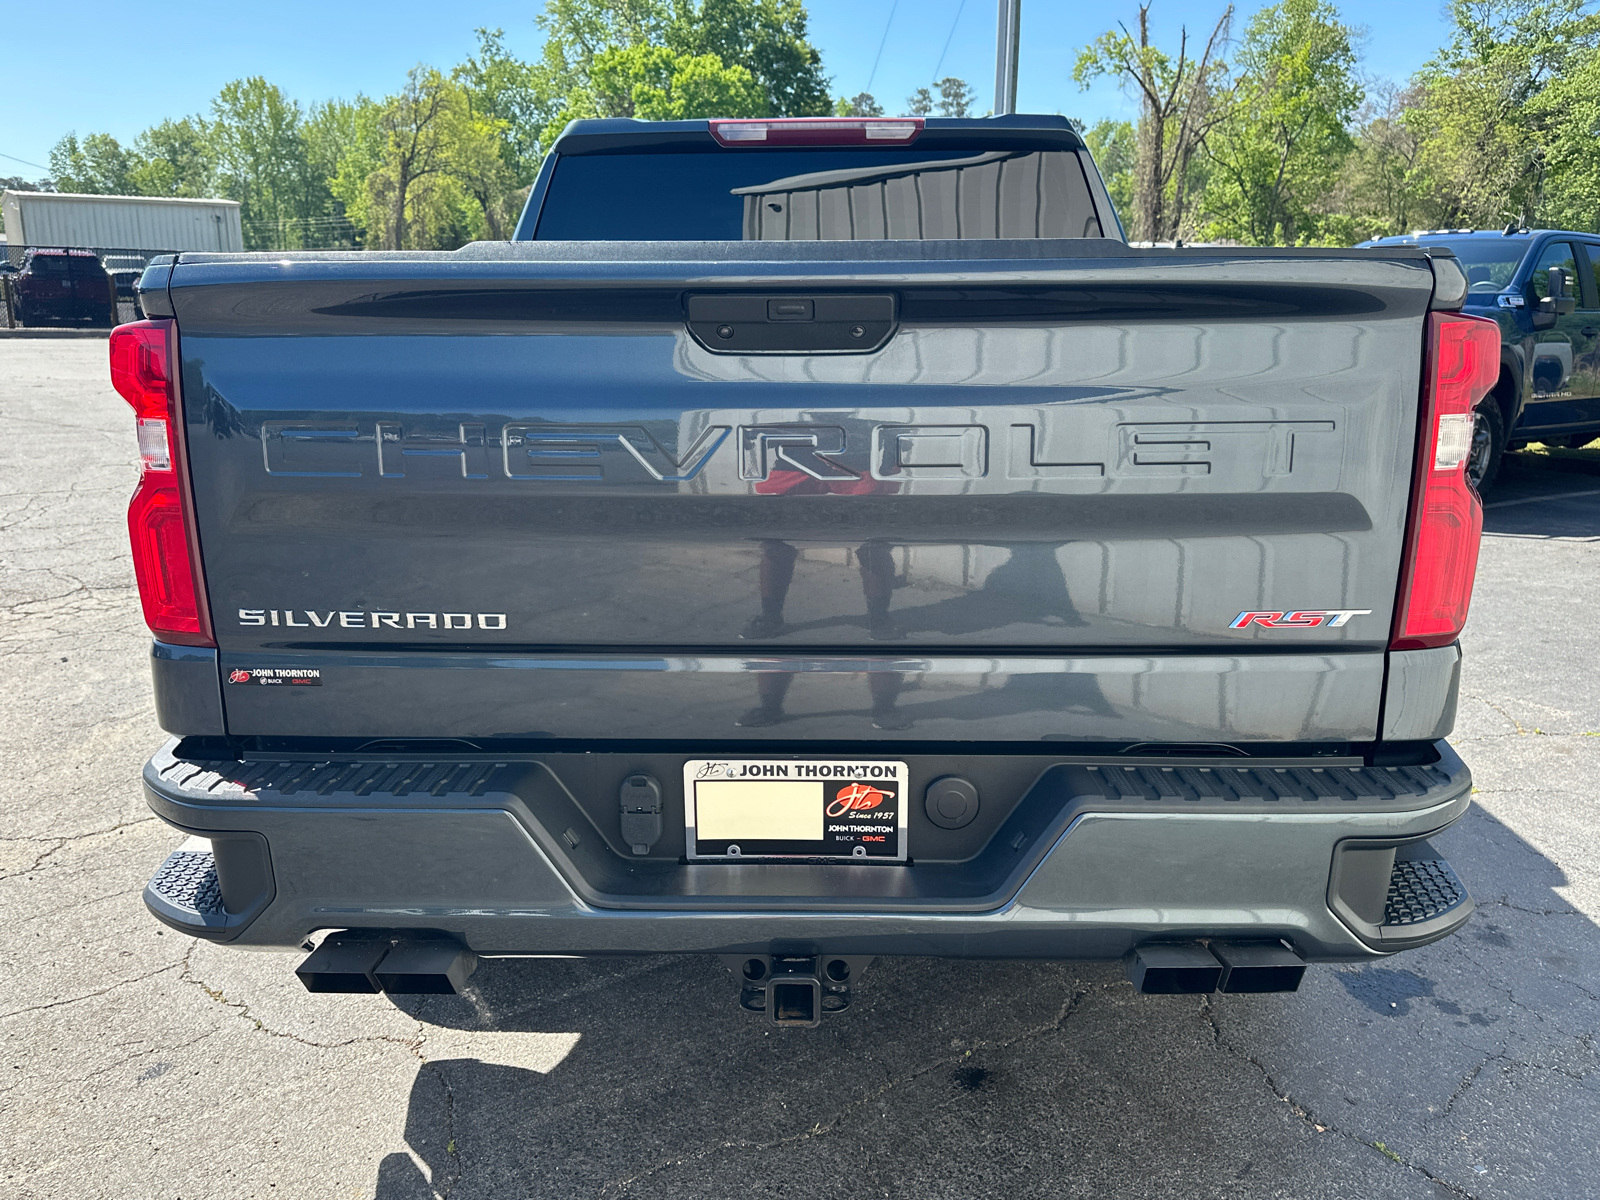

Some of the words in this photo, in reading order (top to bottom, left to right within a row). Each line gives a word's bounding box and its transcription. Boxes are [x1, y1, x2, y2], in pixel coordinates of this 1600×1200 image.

[261, 420, 1335, 480] CHEVROLET
[238, 608, 508, 630] SILVERADO
[1228, 609, 1373, 629] RST
[252, 668, 273, 677] JOHN
[275, 669, 320, 678] THORNTON
[740, 765, 789, 777] JOHN
[794, 765, 897, 778] THORNTON
[848, 811, 872, 819] Since
[873, 812, 895, 820] 1957
[849, 825, 894, 833] THORNTON
